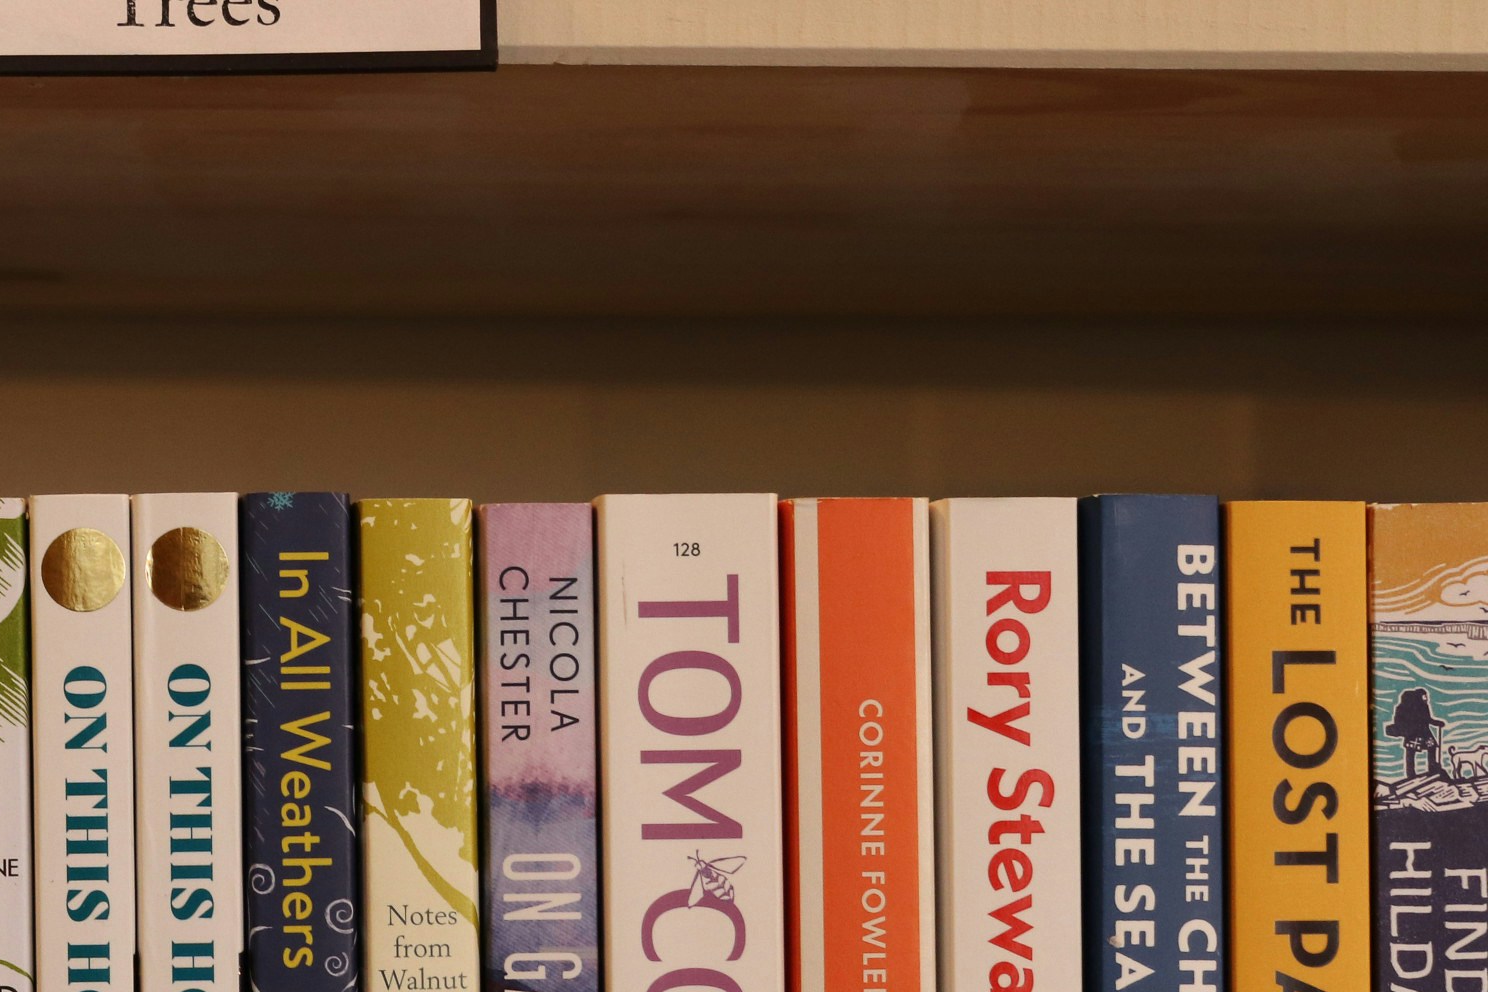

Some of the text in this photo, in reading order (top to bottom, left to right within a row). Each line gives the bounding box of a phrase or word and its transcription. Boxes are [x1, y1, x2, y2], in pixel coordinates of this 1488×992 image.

[673, 542, 701, 557] 128
[1290, 538, 1321, 625] THE
[63, 665, 107, 754] ON
[498, 566, 531, 743] CHESTER
[549, 577, 580, 733] NICOLA
[638, 574, 743, 840] TOM
[967, 571, 1051, 747] Rory
[1177, 544, 1216, 817] BETWEEN
[278, 552, 332, 968] In All Weathers
[858, 699, 885, 856] CORINNE
[1115, 663, 1155, 990] AND THE SEA
[1272, 650, 1339, 884] LOST
[65, 768, 110, 922] THIS
[387, 905, 458, 927] Notes
[502, 852, 582, 921] ON
[1185, 836, 1209, 902] THE
[378, 967, 468, 991] Walnut
[394, 935, 451, 959] from
